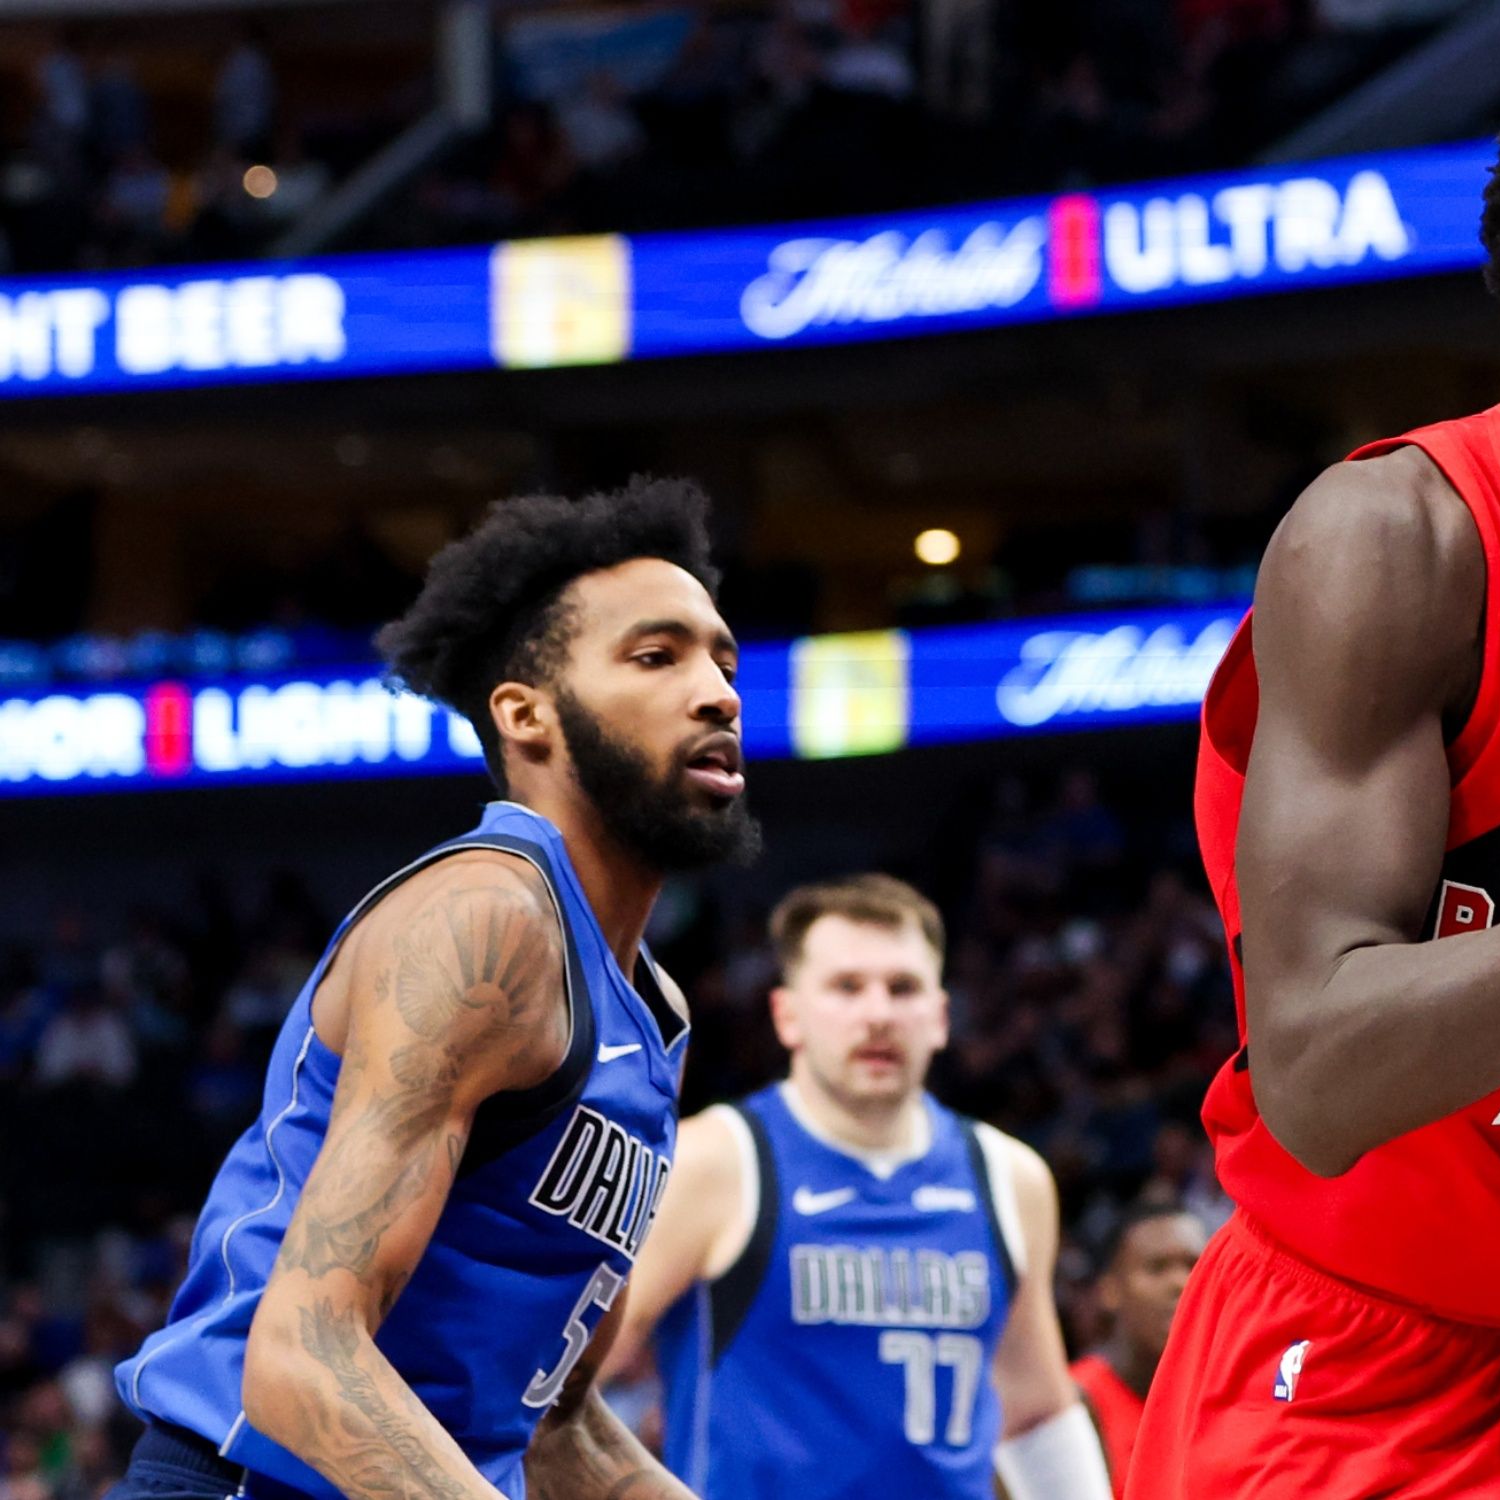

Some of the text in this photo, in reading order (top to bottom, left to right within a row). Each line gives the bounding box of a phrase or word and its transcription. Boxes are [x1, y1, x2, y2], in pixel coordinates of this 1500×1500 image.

[1104, 171, 1413, 293] ULTRA
[115, 273, 347, 375] BEER
[193, 678, 437, 772] LIGHT
[789, 1244, 991, 1330] DALLAS
[879, 1330, 983, 1447] 77
